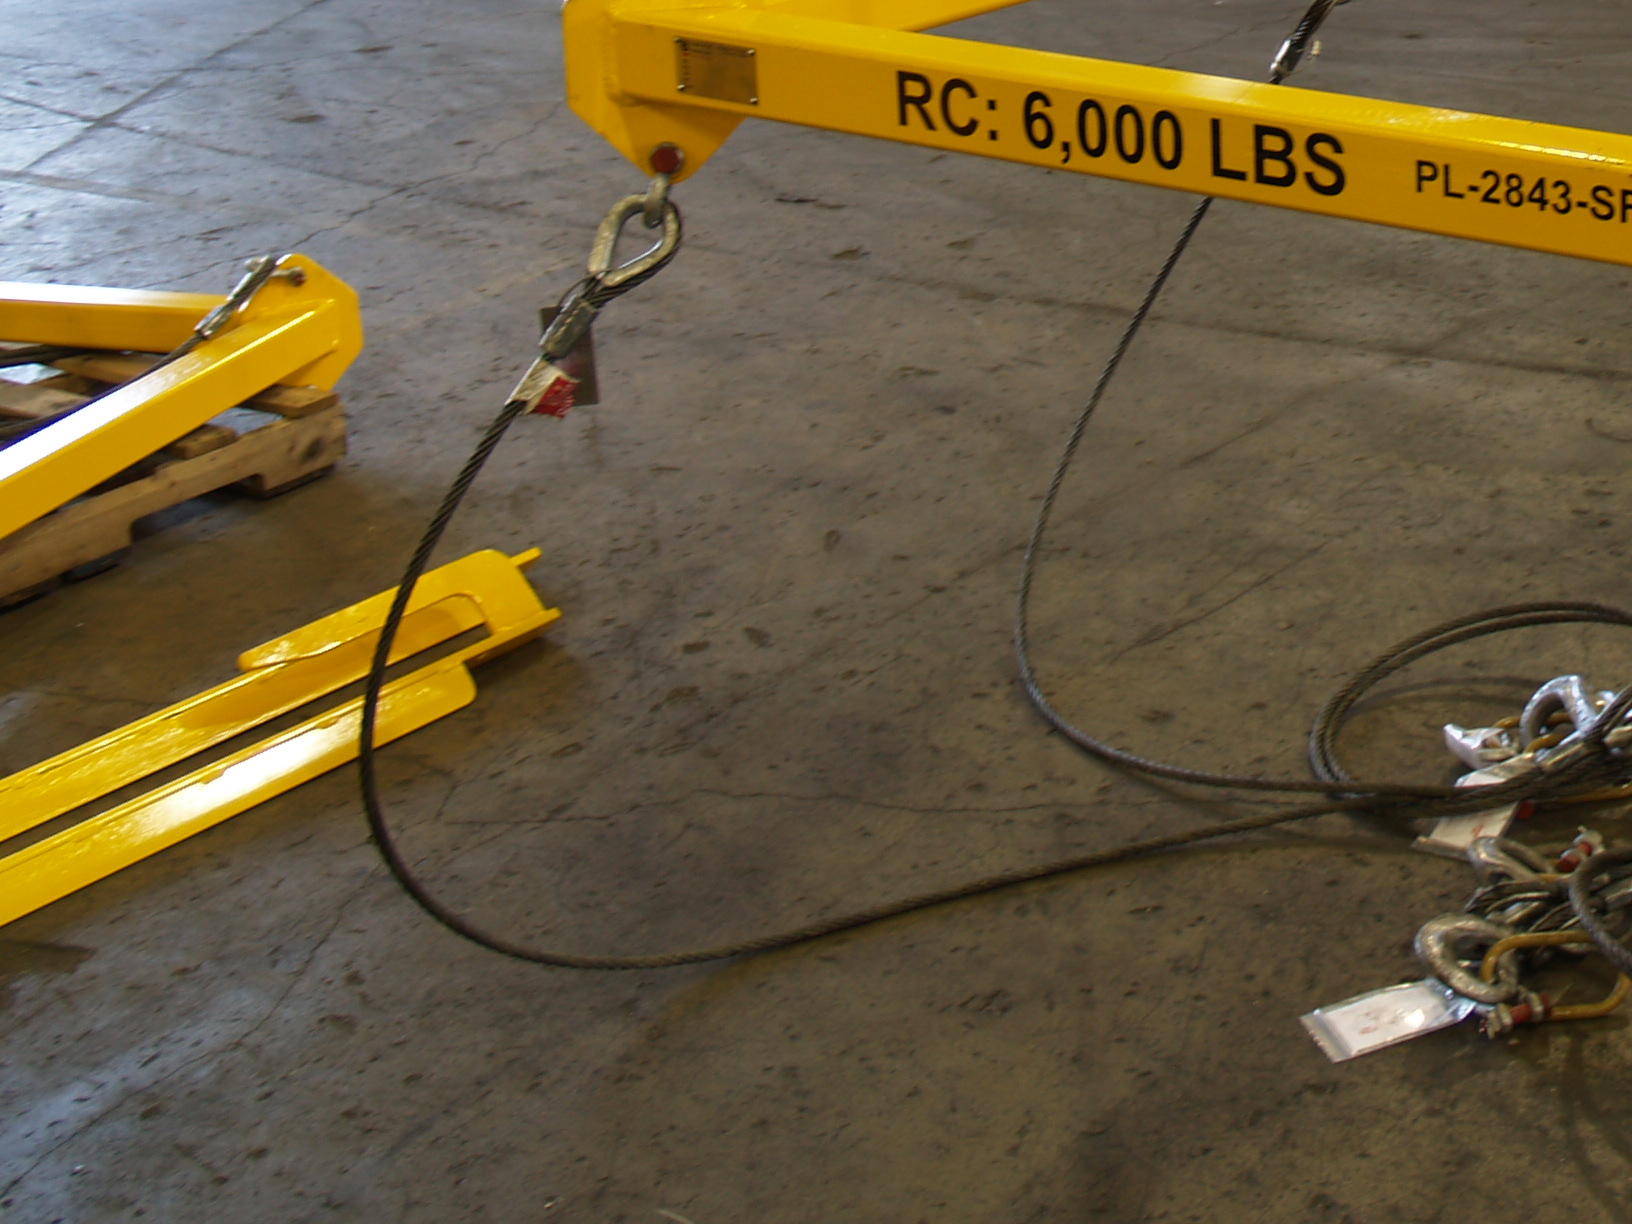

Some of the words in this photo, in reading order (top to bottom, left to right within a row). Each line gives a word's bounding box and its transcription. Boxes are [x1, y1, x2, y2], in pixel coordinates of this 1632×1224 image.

[896, 70, 998, 141] RC:
[1023, 91, 1183, 170] 6,000
[1211, 118, 1346, 196] LBS
